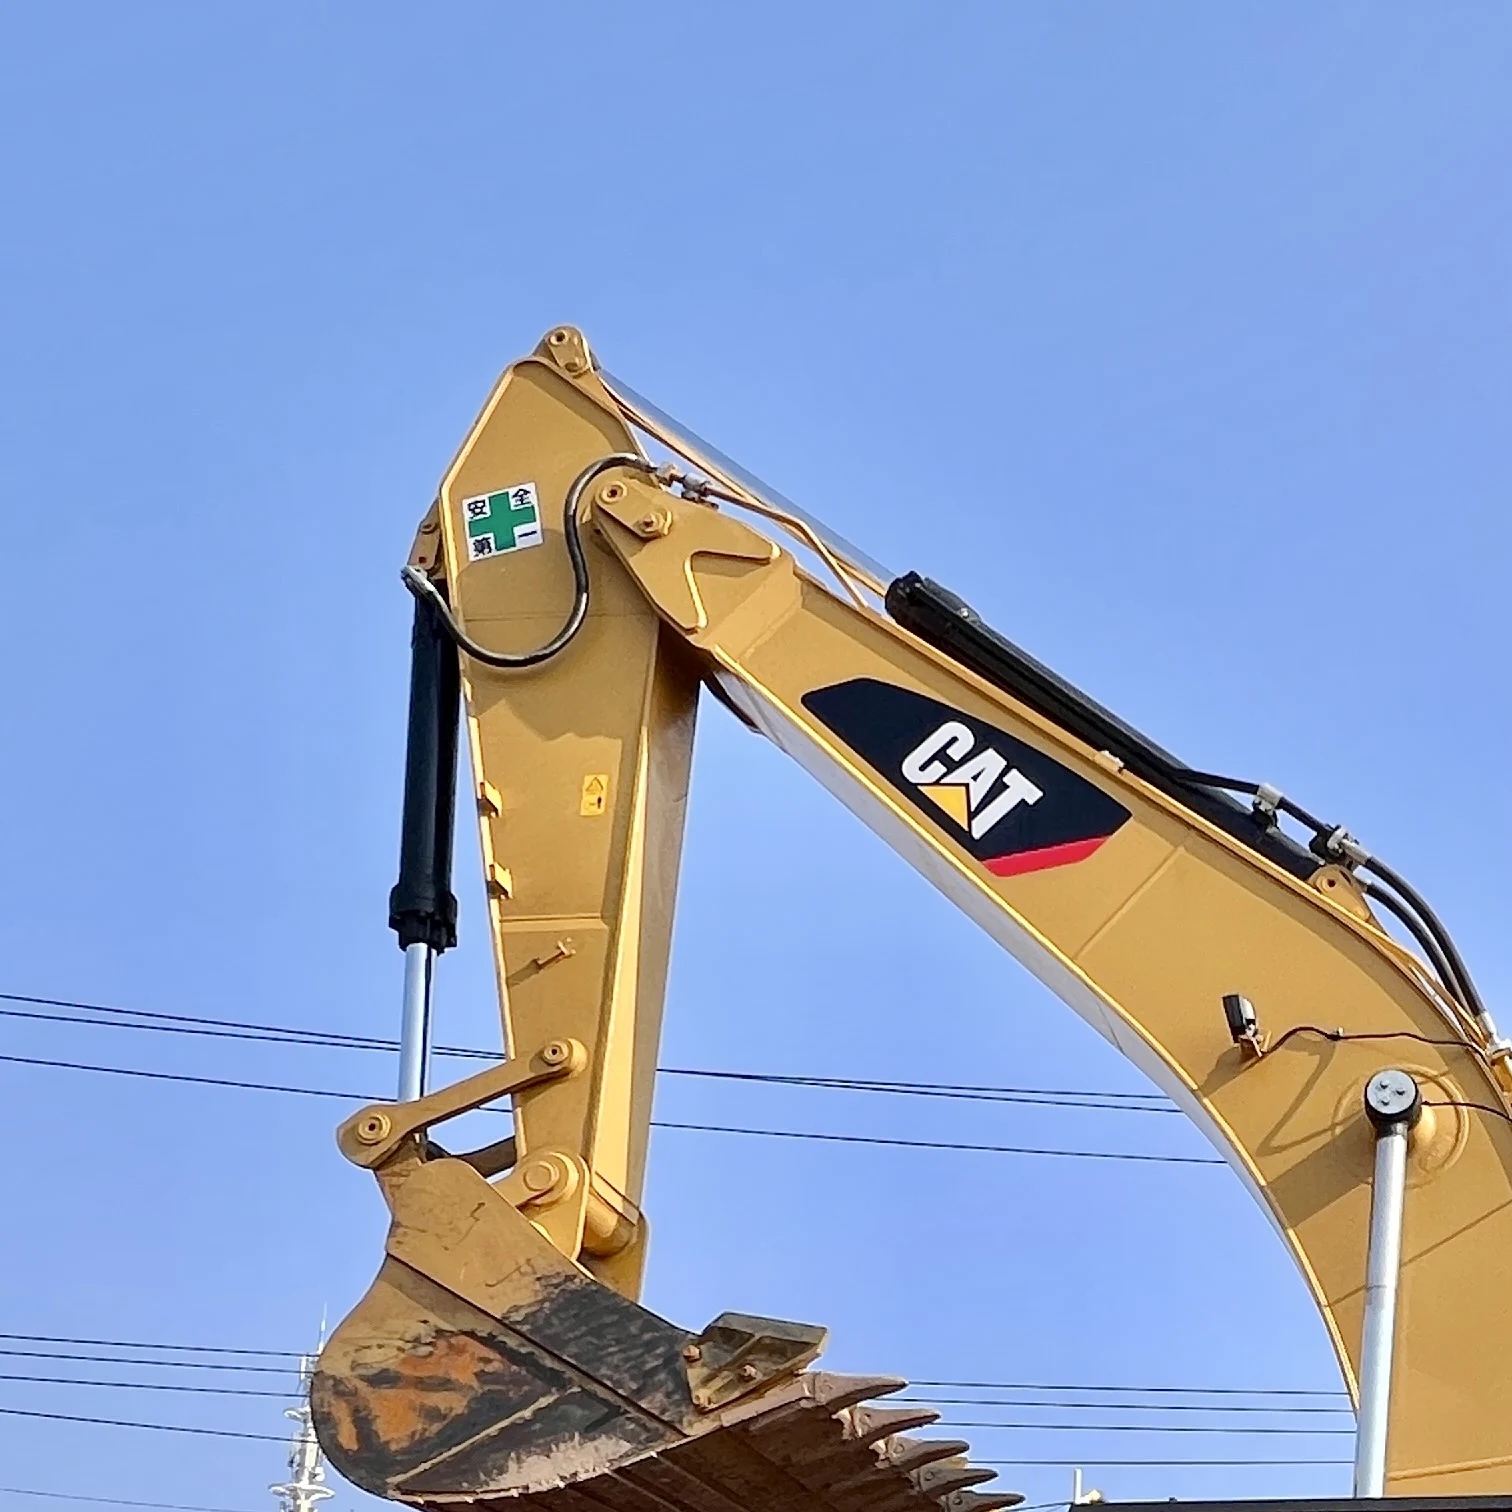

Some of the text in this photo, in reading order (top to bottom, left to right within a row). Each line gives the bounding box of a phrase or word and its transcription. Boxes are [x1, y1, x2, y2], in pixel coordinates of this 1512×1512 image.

[467, 488, 532, 520] 安全
[472, 530, 538, 558] 第一
[901, 720, 1045, 841] CAT
